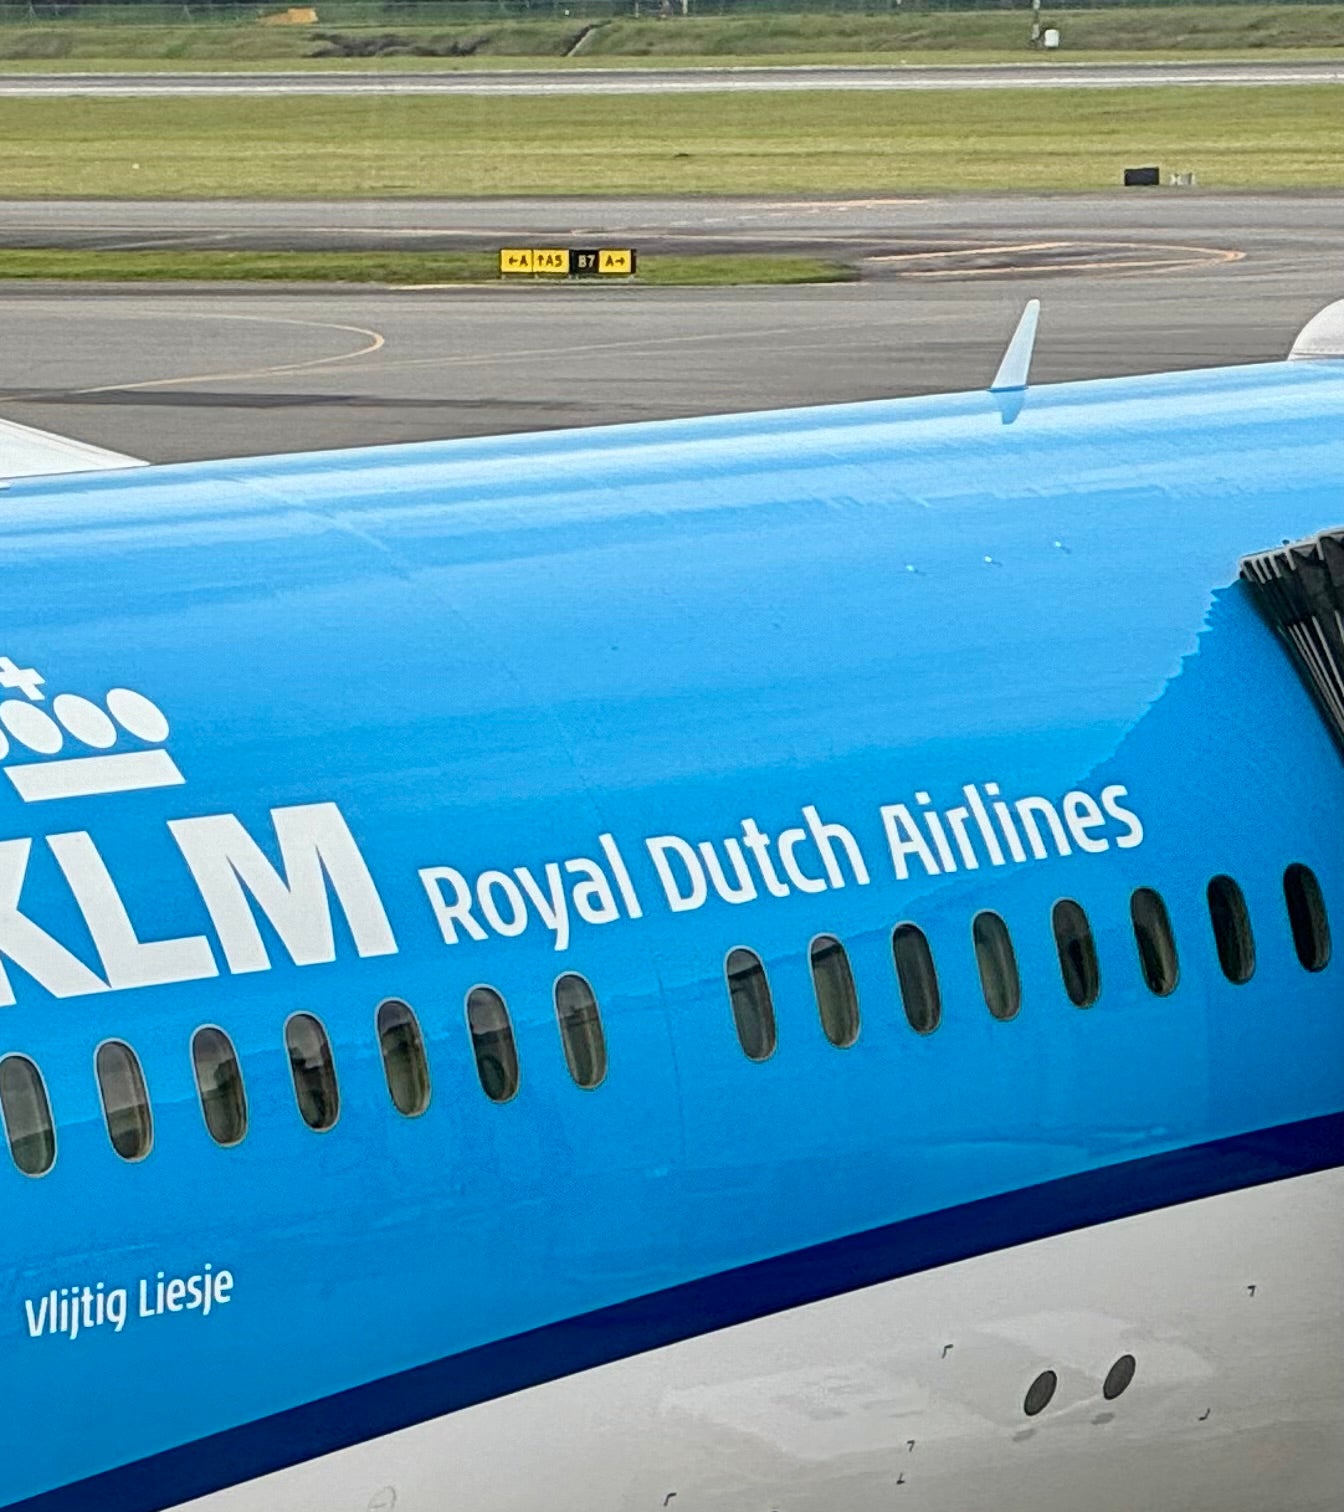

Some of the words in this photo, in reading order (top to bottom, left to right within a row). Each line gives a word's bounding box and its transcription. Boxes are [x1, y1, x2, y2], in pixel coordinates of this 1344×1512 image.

[578, 254, 596, 268] B7
[605, 255, 614, 267] A
[417, 832, 644, 952] Royal
[645, 805, 871, 914] Dutch
[879, 781, 1144, 881] Airlines
[24, 1282, 127, 1341] Vlijtig
[139, 1263, 234, 1318] Liesje
